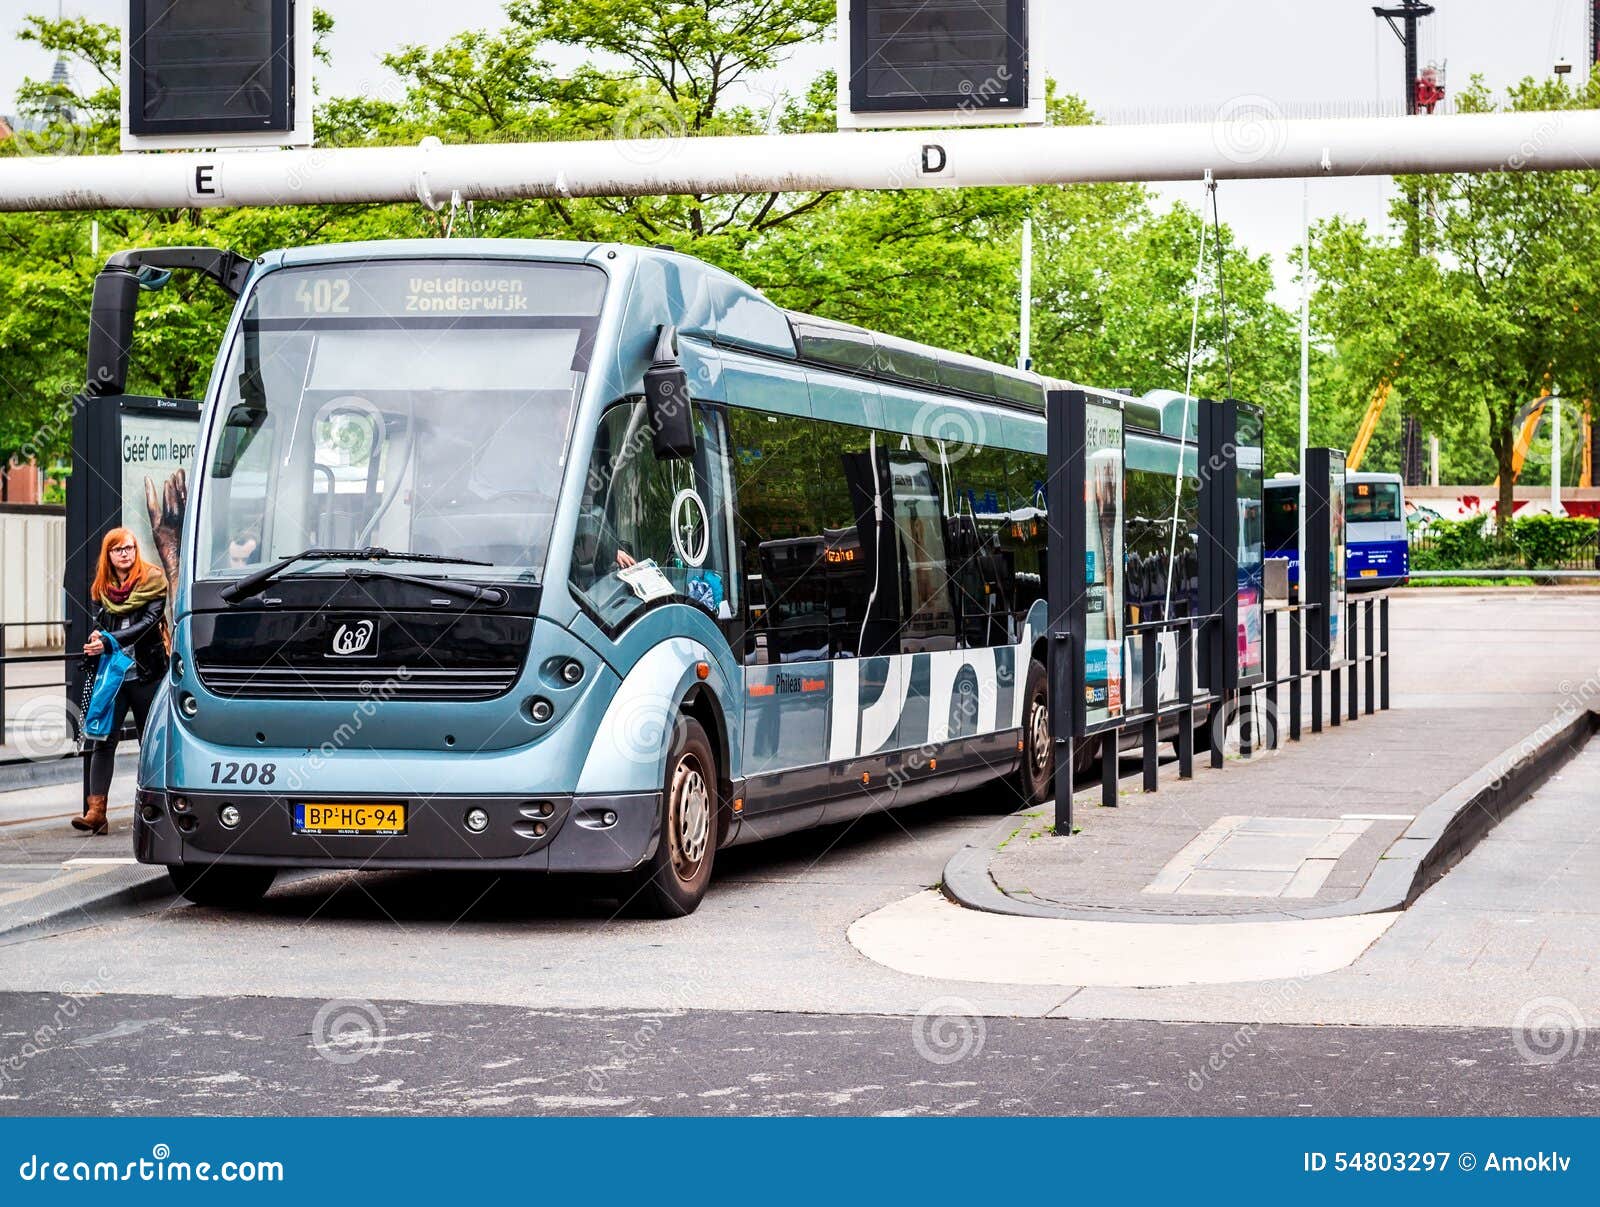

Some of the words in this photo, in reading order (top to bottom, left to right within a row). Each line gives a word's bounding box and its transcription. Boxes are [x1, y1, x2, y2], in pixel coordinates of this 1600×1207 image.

[922, 145, 946, 173] D
[196, 166, 215, 193] E
[295, 278, 350, 313] 402
[409, 278, 522, 294] Veldhoven
[406, 295, 527, 312] Zonderwijk
[123, 435, 149, 463] Gééf
[152, 443, 168, 461] om
[776, 673, 801, 694] Phileas
[210, 762, 276, 785] 1208
